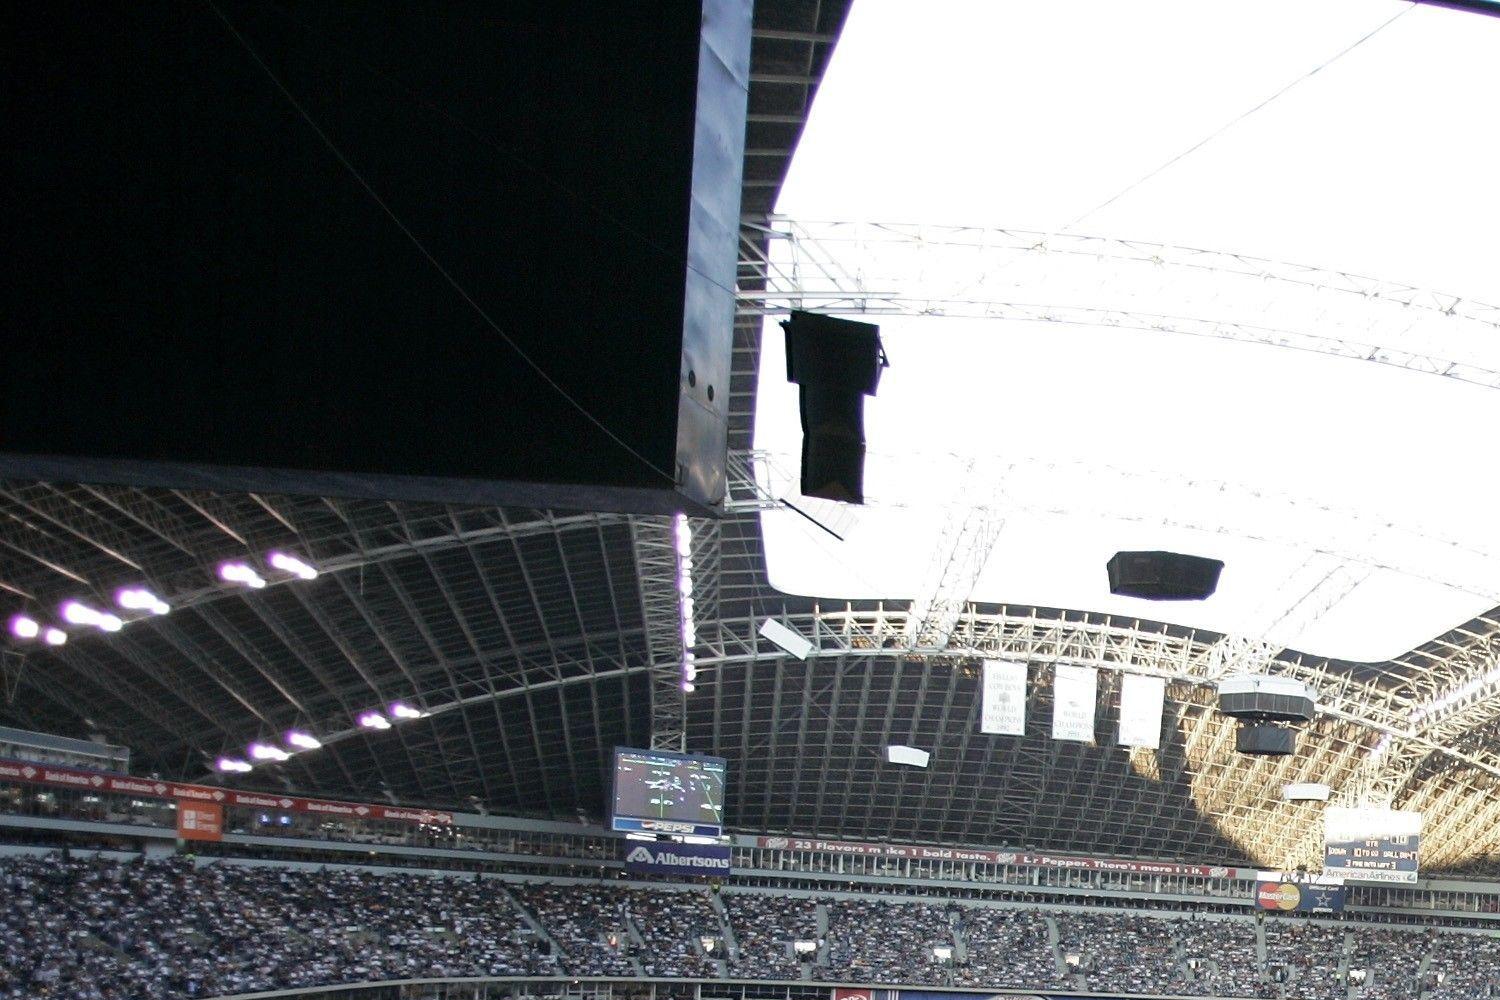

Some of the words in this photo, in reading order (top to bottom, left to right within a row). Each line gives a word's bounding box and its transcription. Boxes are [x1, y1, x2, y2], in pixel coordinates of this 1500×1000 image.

[654, 822, 695, 834] PEPSI
[795, 841, 812, 850] 23
[816, 842, 864, 853] Flavors
[911, 848, 917, 856] 1
[923, 848, 952, 859] bold
[956, 851, 990, 862] taste.
[655, 852, 730, 869] Albertsons
[1042, 857, 1090, 869] Pepper.
[1094, 860, 1137, 872] There's
[1140, 864, 1172, 873] more
[1258, 891, 1300, 902] MasterCard
